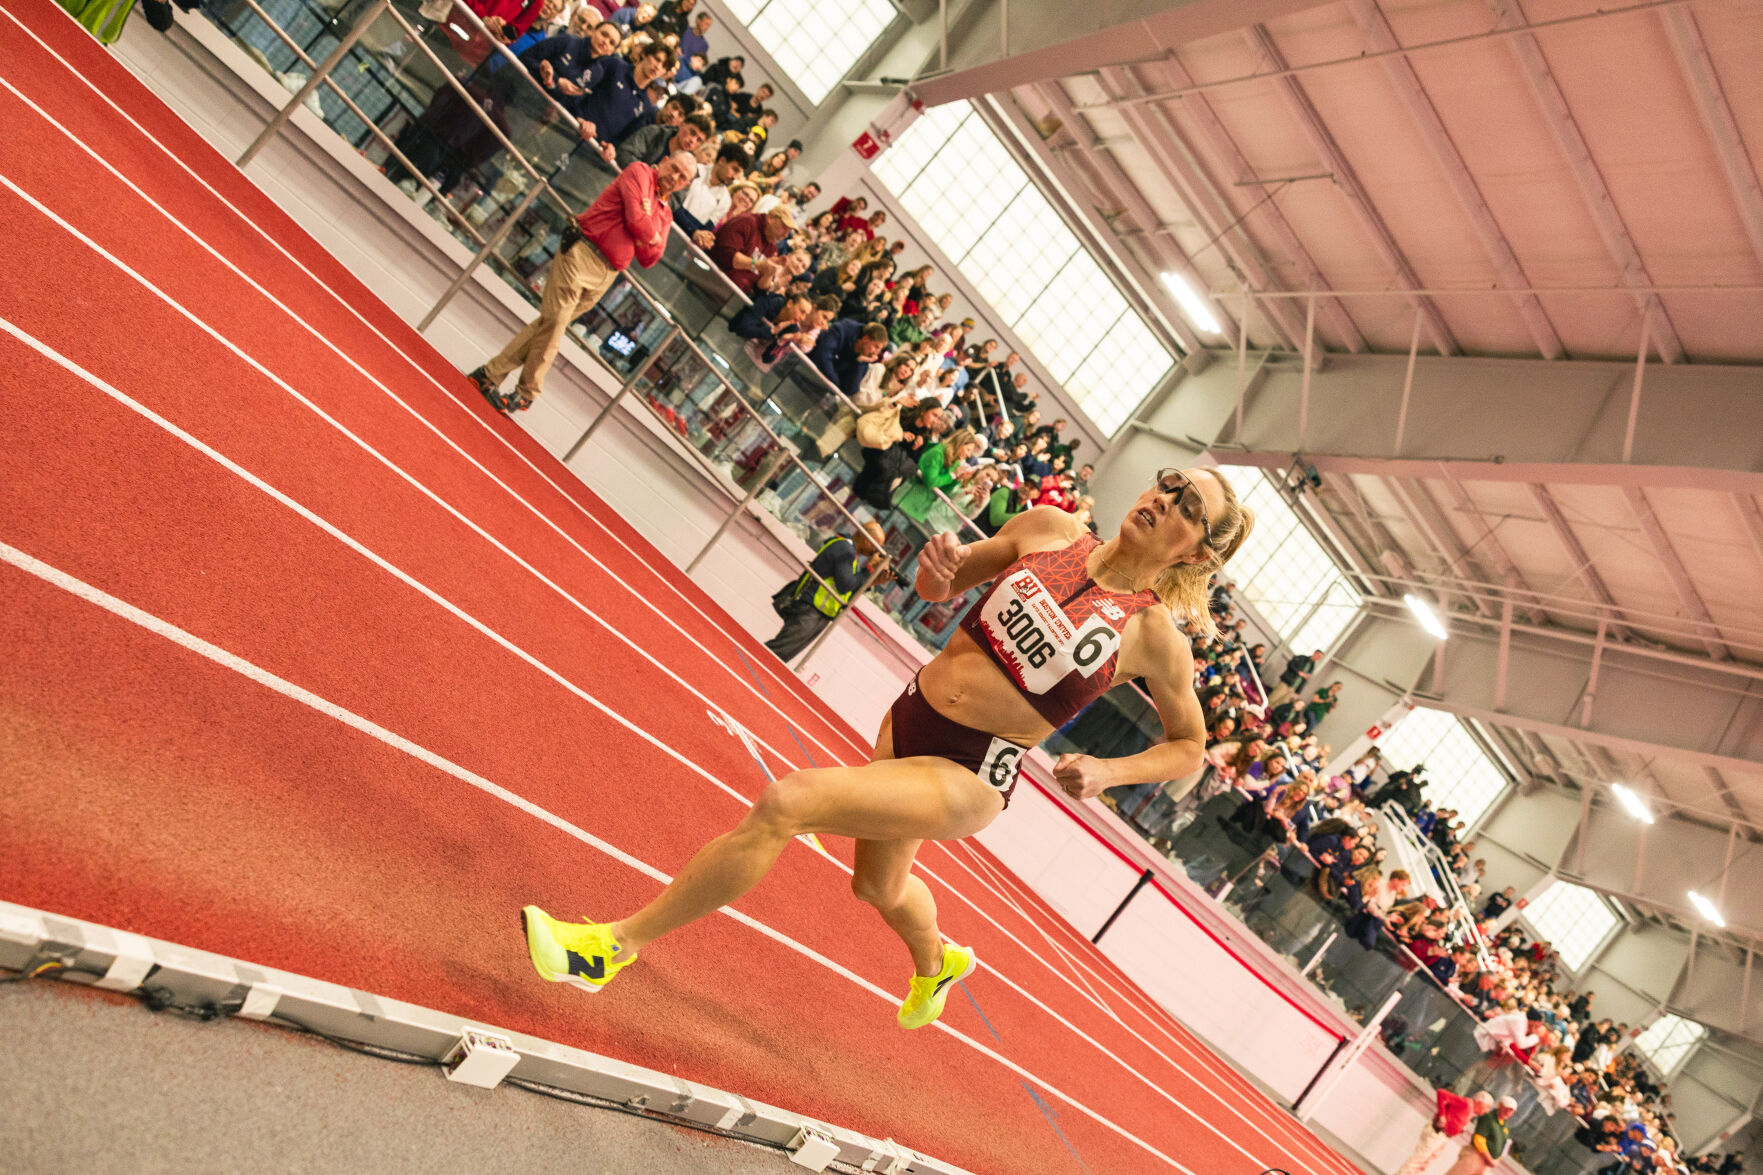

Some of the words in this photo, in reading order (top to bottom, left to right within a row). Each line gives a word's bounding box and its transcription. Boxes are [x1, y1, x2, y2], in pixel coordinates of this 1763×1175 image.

[1014, 575, 1042, 599] BU
[1039, 598, 1058, 620] BOSTON
[998, 598, 1056, 669] 3006
[1072, 626, 1116, 666] 6
[989, 746, 1019, 786] 6
